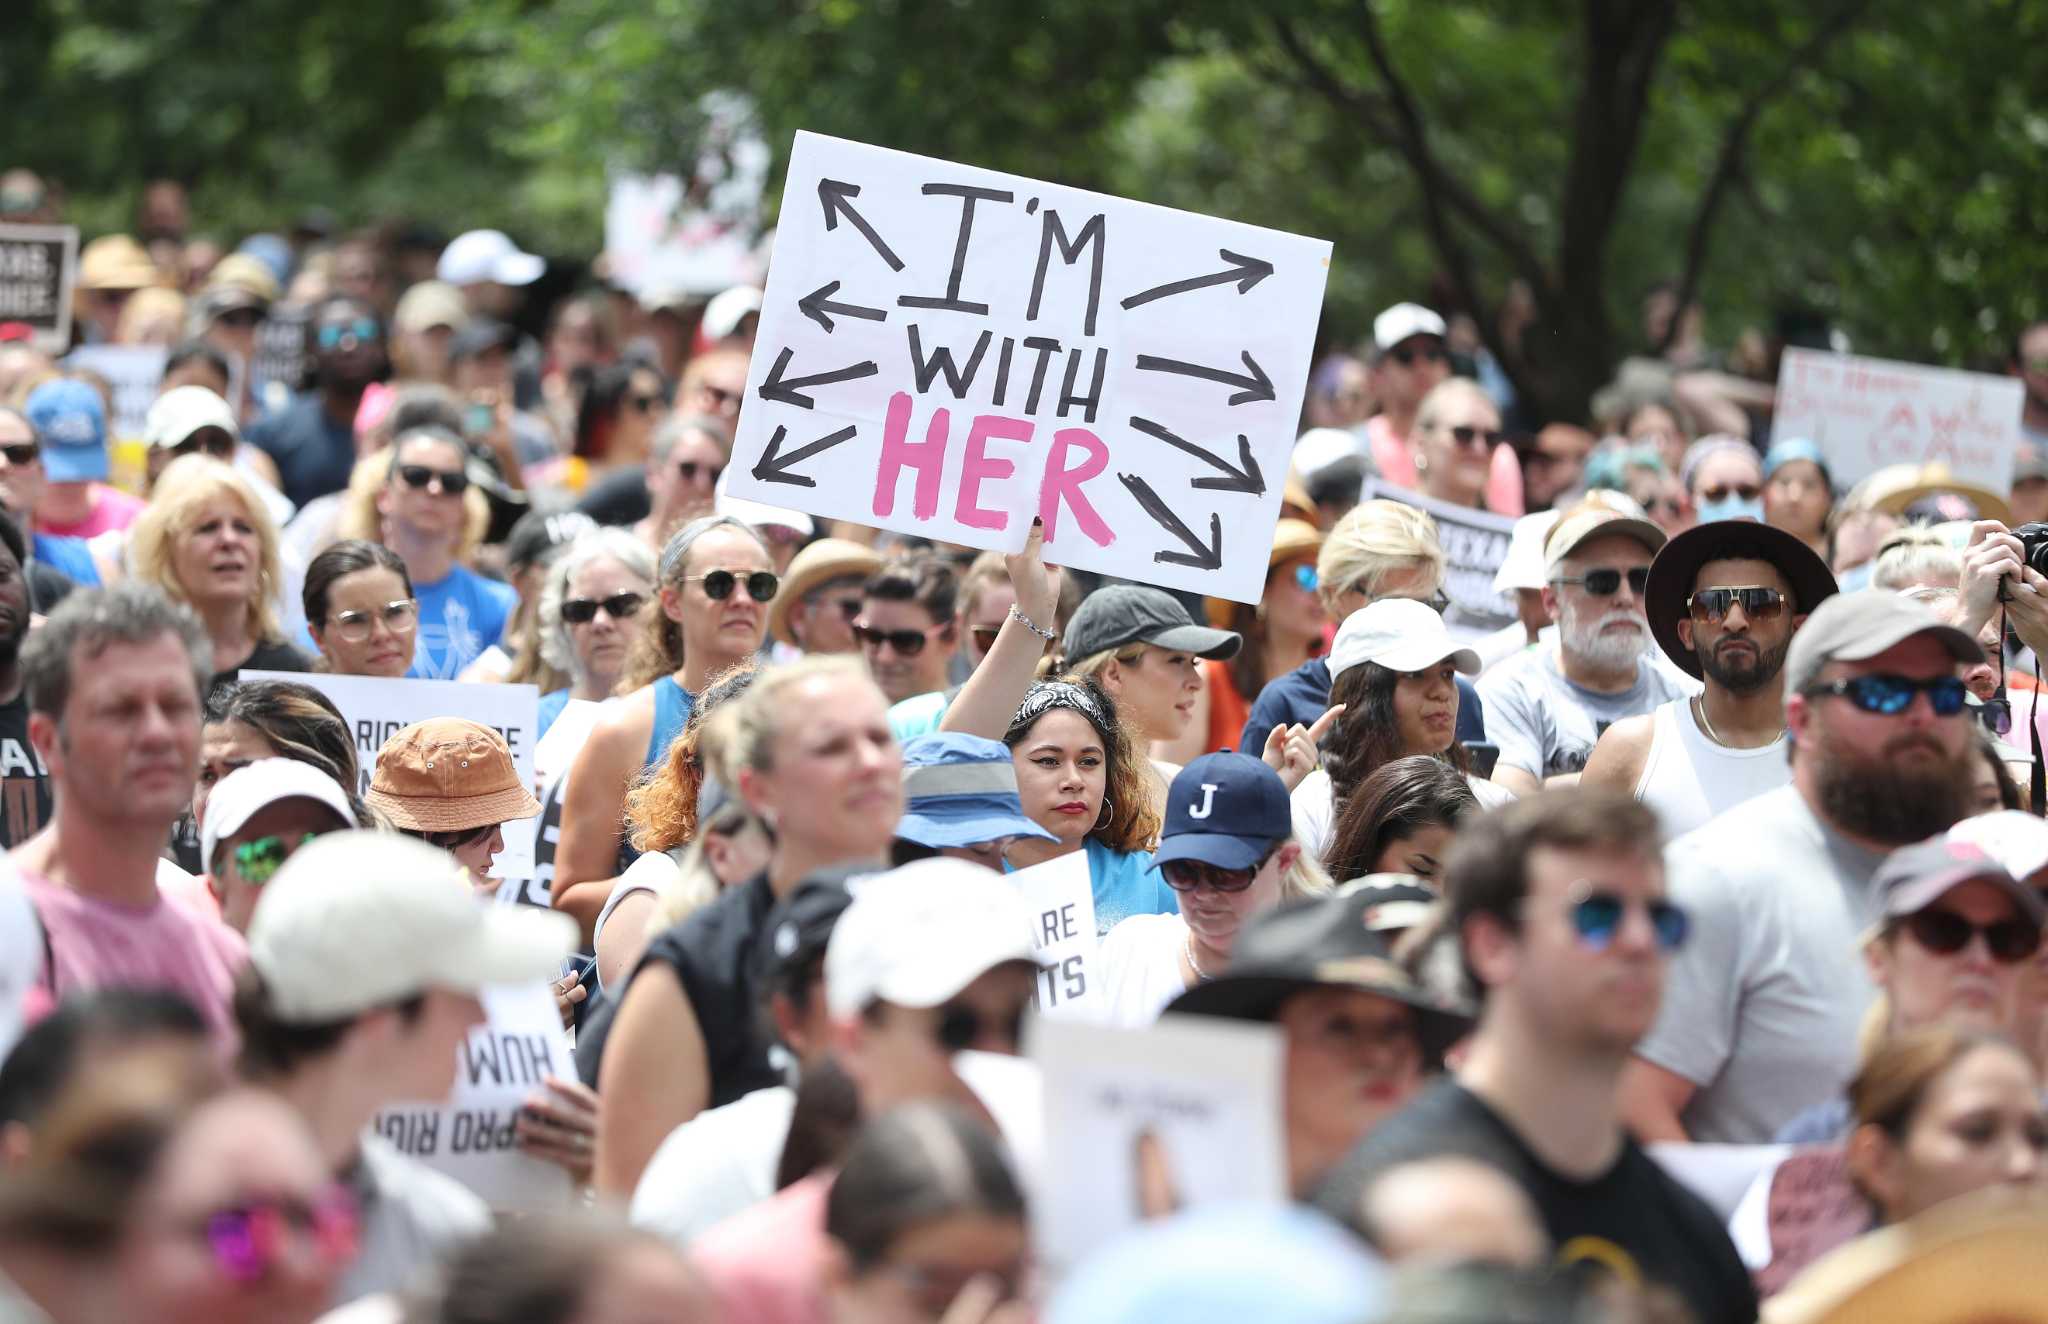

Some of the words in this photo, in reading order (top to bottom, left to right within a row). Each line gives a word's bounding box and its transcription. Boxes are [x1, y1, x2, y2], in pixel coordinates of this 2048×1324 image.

[897, 182, 1106, 337] I'M
[907, 323, 1109, 424] WITH
[871, 391, 1118, 549] HER
[1189, 783, 1218, 819] J
